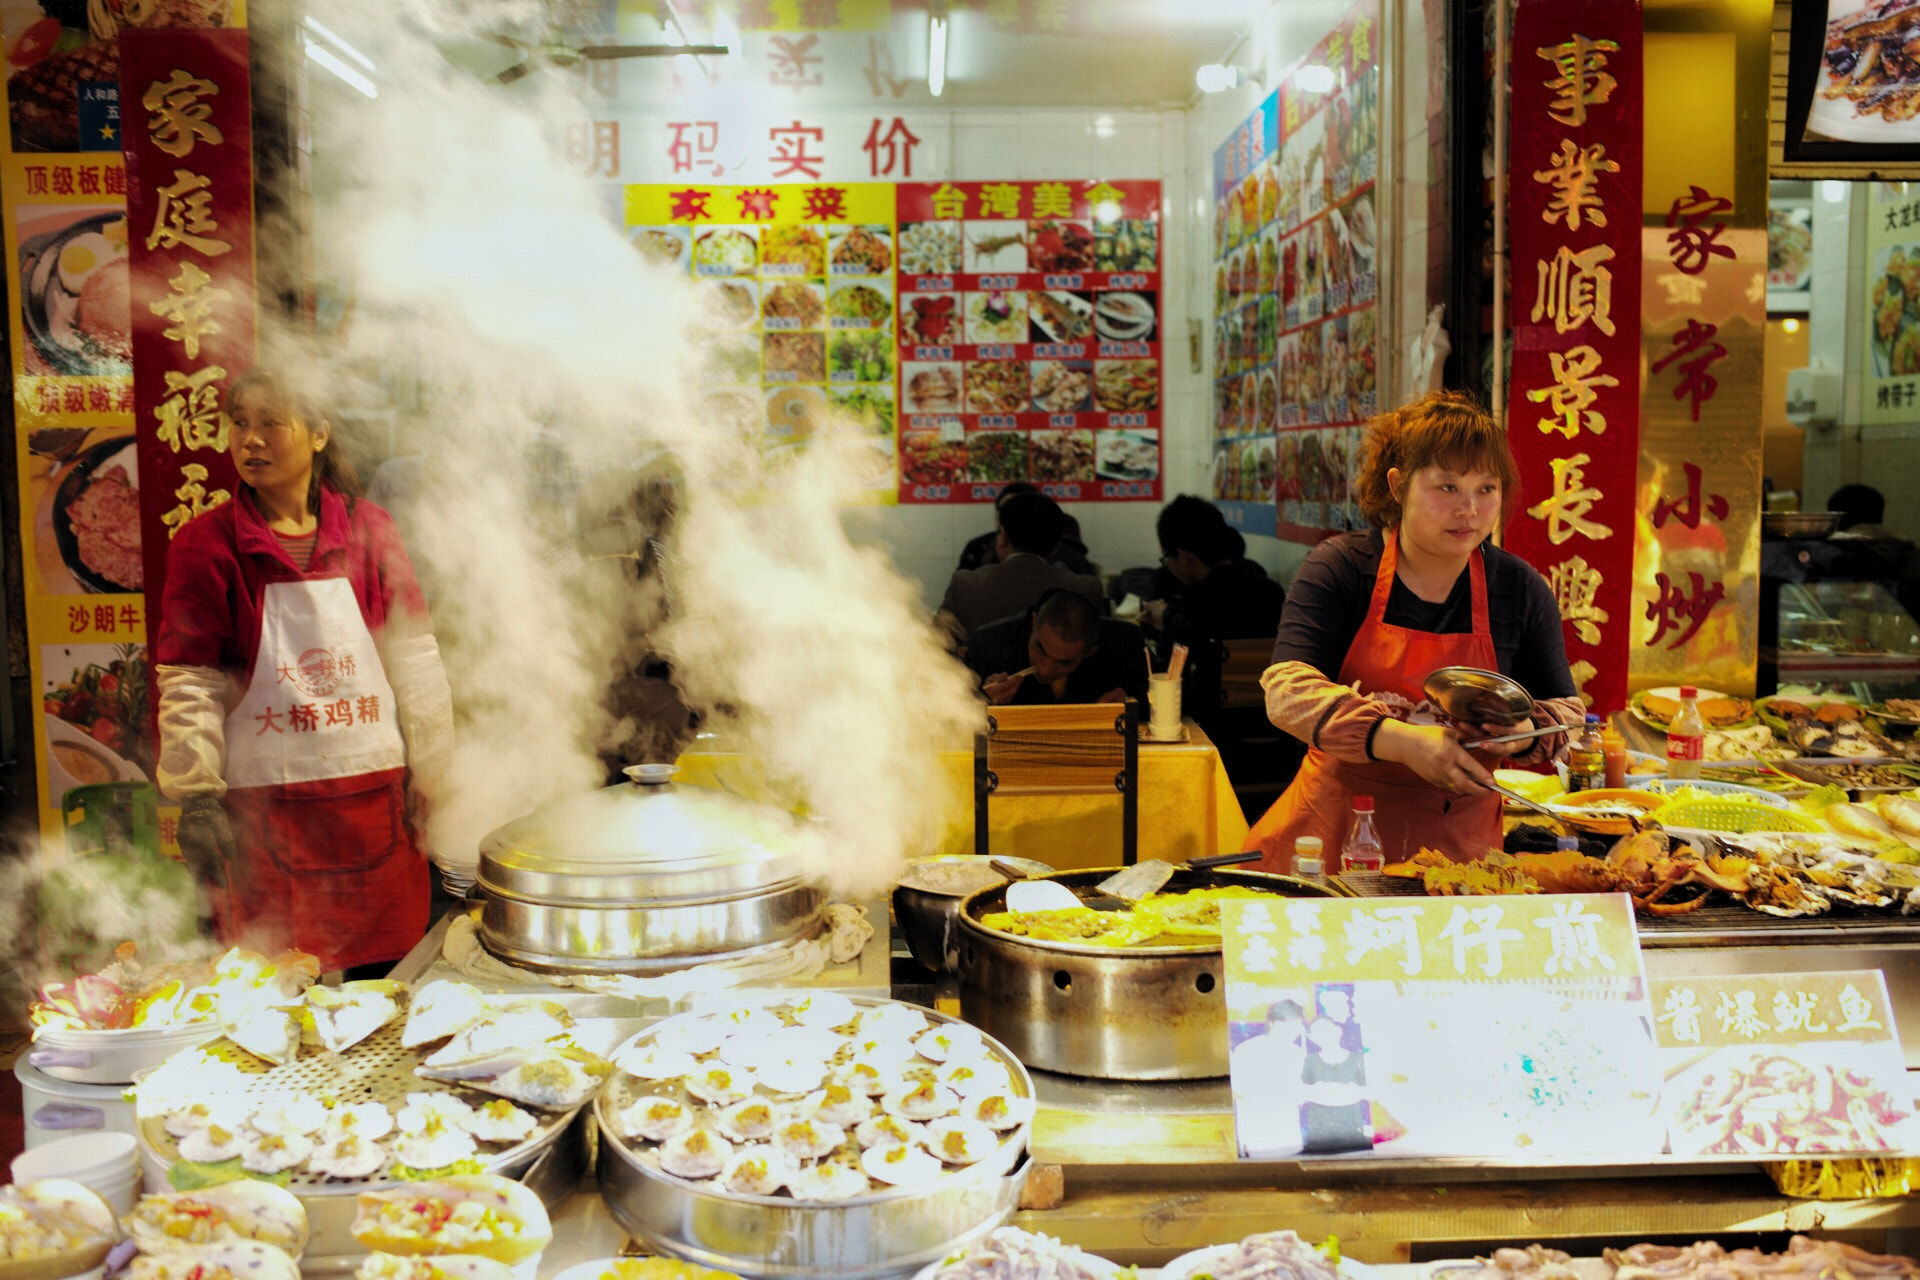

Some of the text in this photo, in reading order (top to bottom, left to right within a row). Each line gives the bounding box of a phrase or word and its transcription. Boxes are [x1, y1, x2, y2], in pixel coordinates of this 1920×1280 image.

[564, 117, 921, 179] 明码实价
[669, 188, 848, 222] 家常菜
[930, 183, 1126, 219] 台湾美食
[142, 69, 233, 541] 家庭幸福永
[1646, 185, 1737, 651] 家常小炒
[68, 603, 147, 634] 沙朗牛
[255, 694, 380, 737] 大桥鸡精
[1343, 899, 1617, 977] 蚵仔煎
